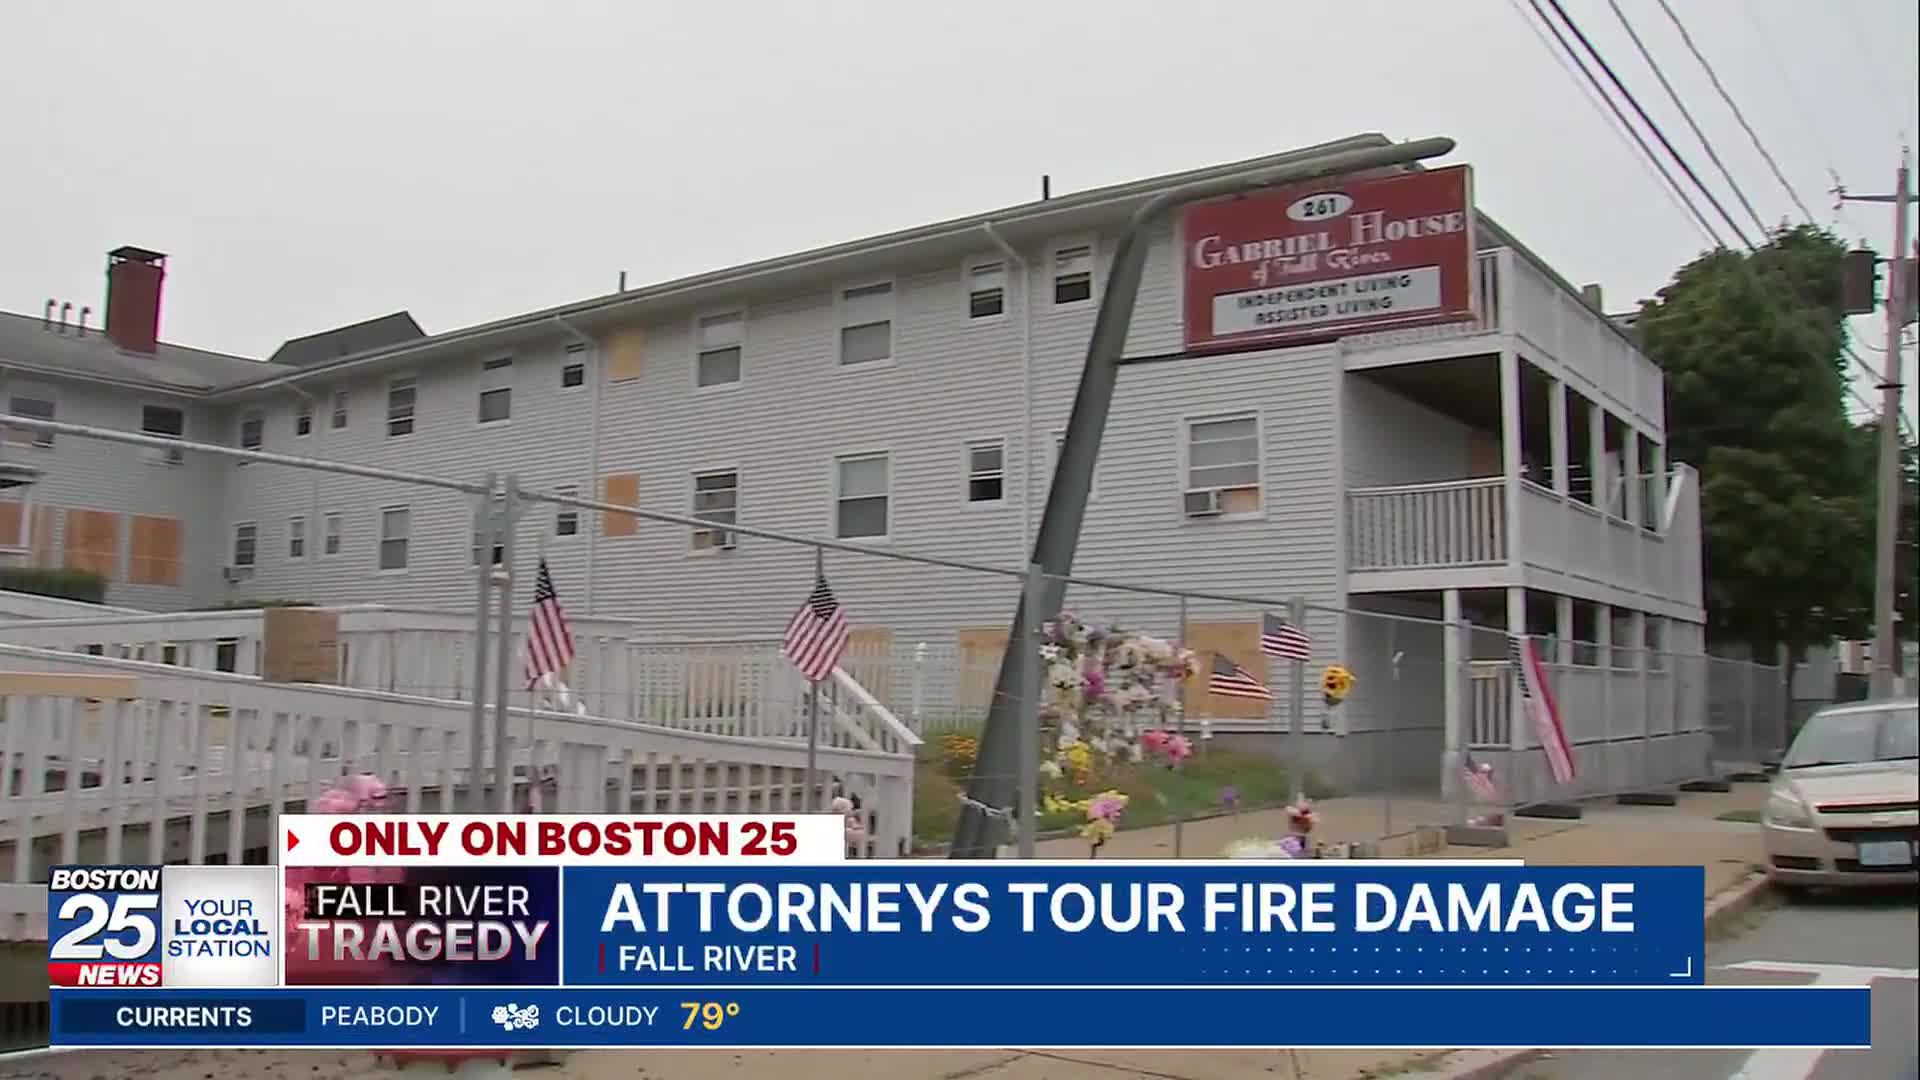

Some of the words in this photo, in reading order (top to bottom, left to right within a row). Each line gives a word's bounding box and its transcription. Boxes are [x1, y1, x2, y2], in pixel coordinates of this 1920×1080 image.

[1303, 198, 1336, 217] 261
[1252, 260, 1270, 286] of
[1274, 253, 1320, 275] Fall
[1327, 248, 1392, 270] River
[1237, 281, 1348, 310] INDEPENDENT
[1354, 274, 1412, 294] LIVING
[1255, 303, 1330, 325] ASSISTED
[1336, 296, 1393, 315] LIVING
